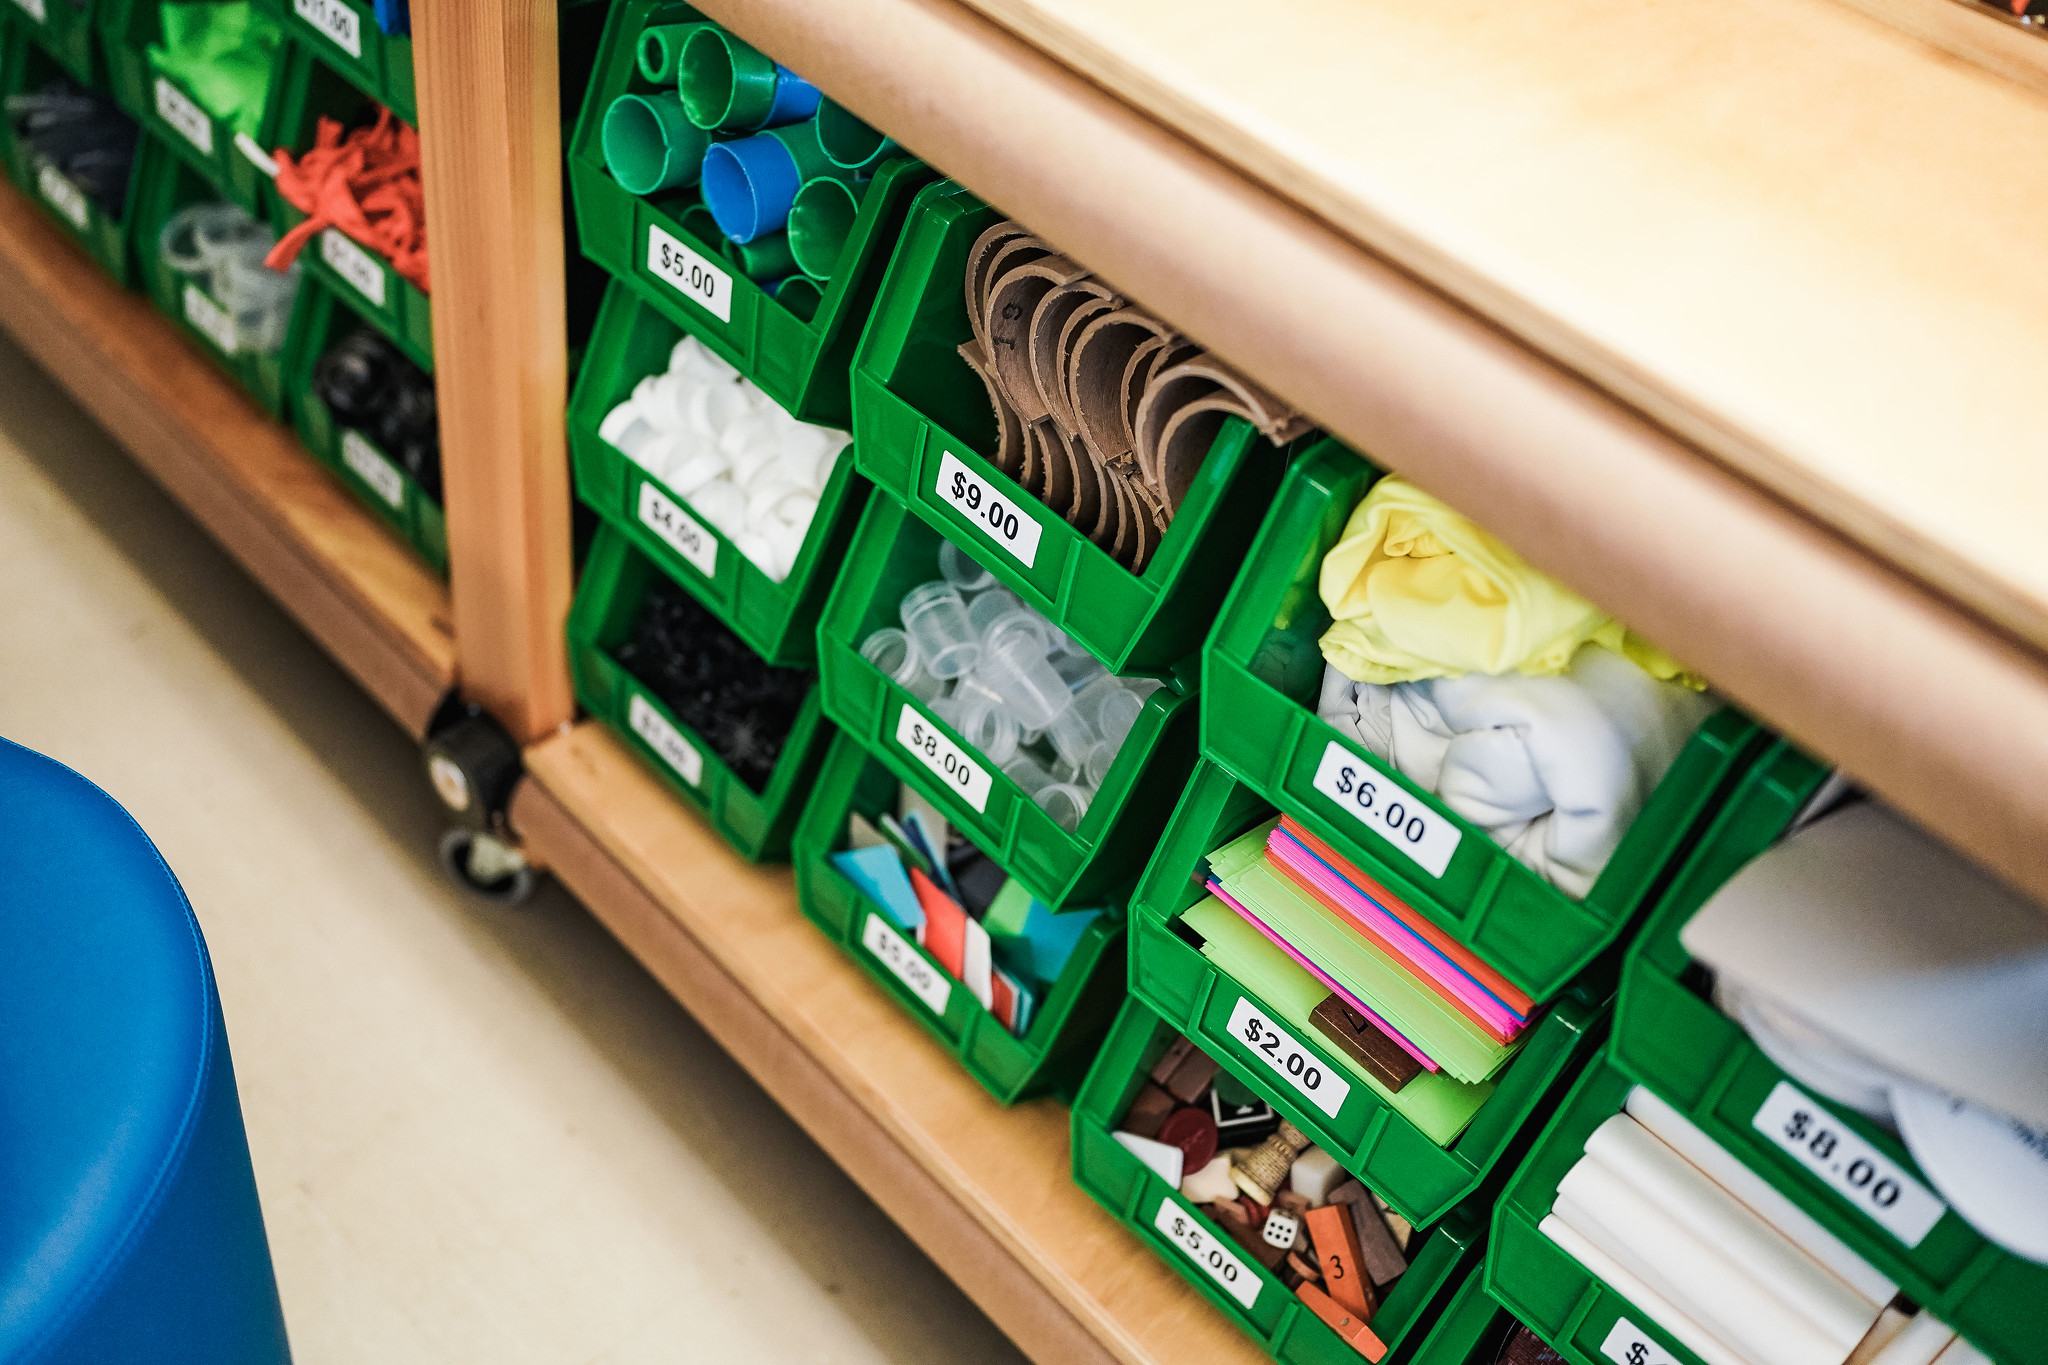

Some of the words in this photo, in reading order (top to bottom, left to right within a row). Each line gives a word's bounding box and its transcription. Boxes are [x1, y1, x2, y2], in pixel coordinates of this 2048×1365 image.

[661, 242, 715, 298] $5.00
[951, 471, 1019, 541] $9.00
[912, 723, 970, 786] $8.00
[1336, 766, 1425, 843] $6.00
[1244, 1018, 1322, 1091] $2.00
[1783, 1110, 1901, 1210] $8.00
[1172, 1217, 1238, 1283] $5.00
[1329, 1255, 1345, 1280] 3
